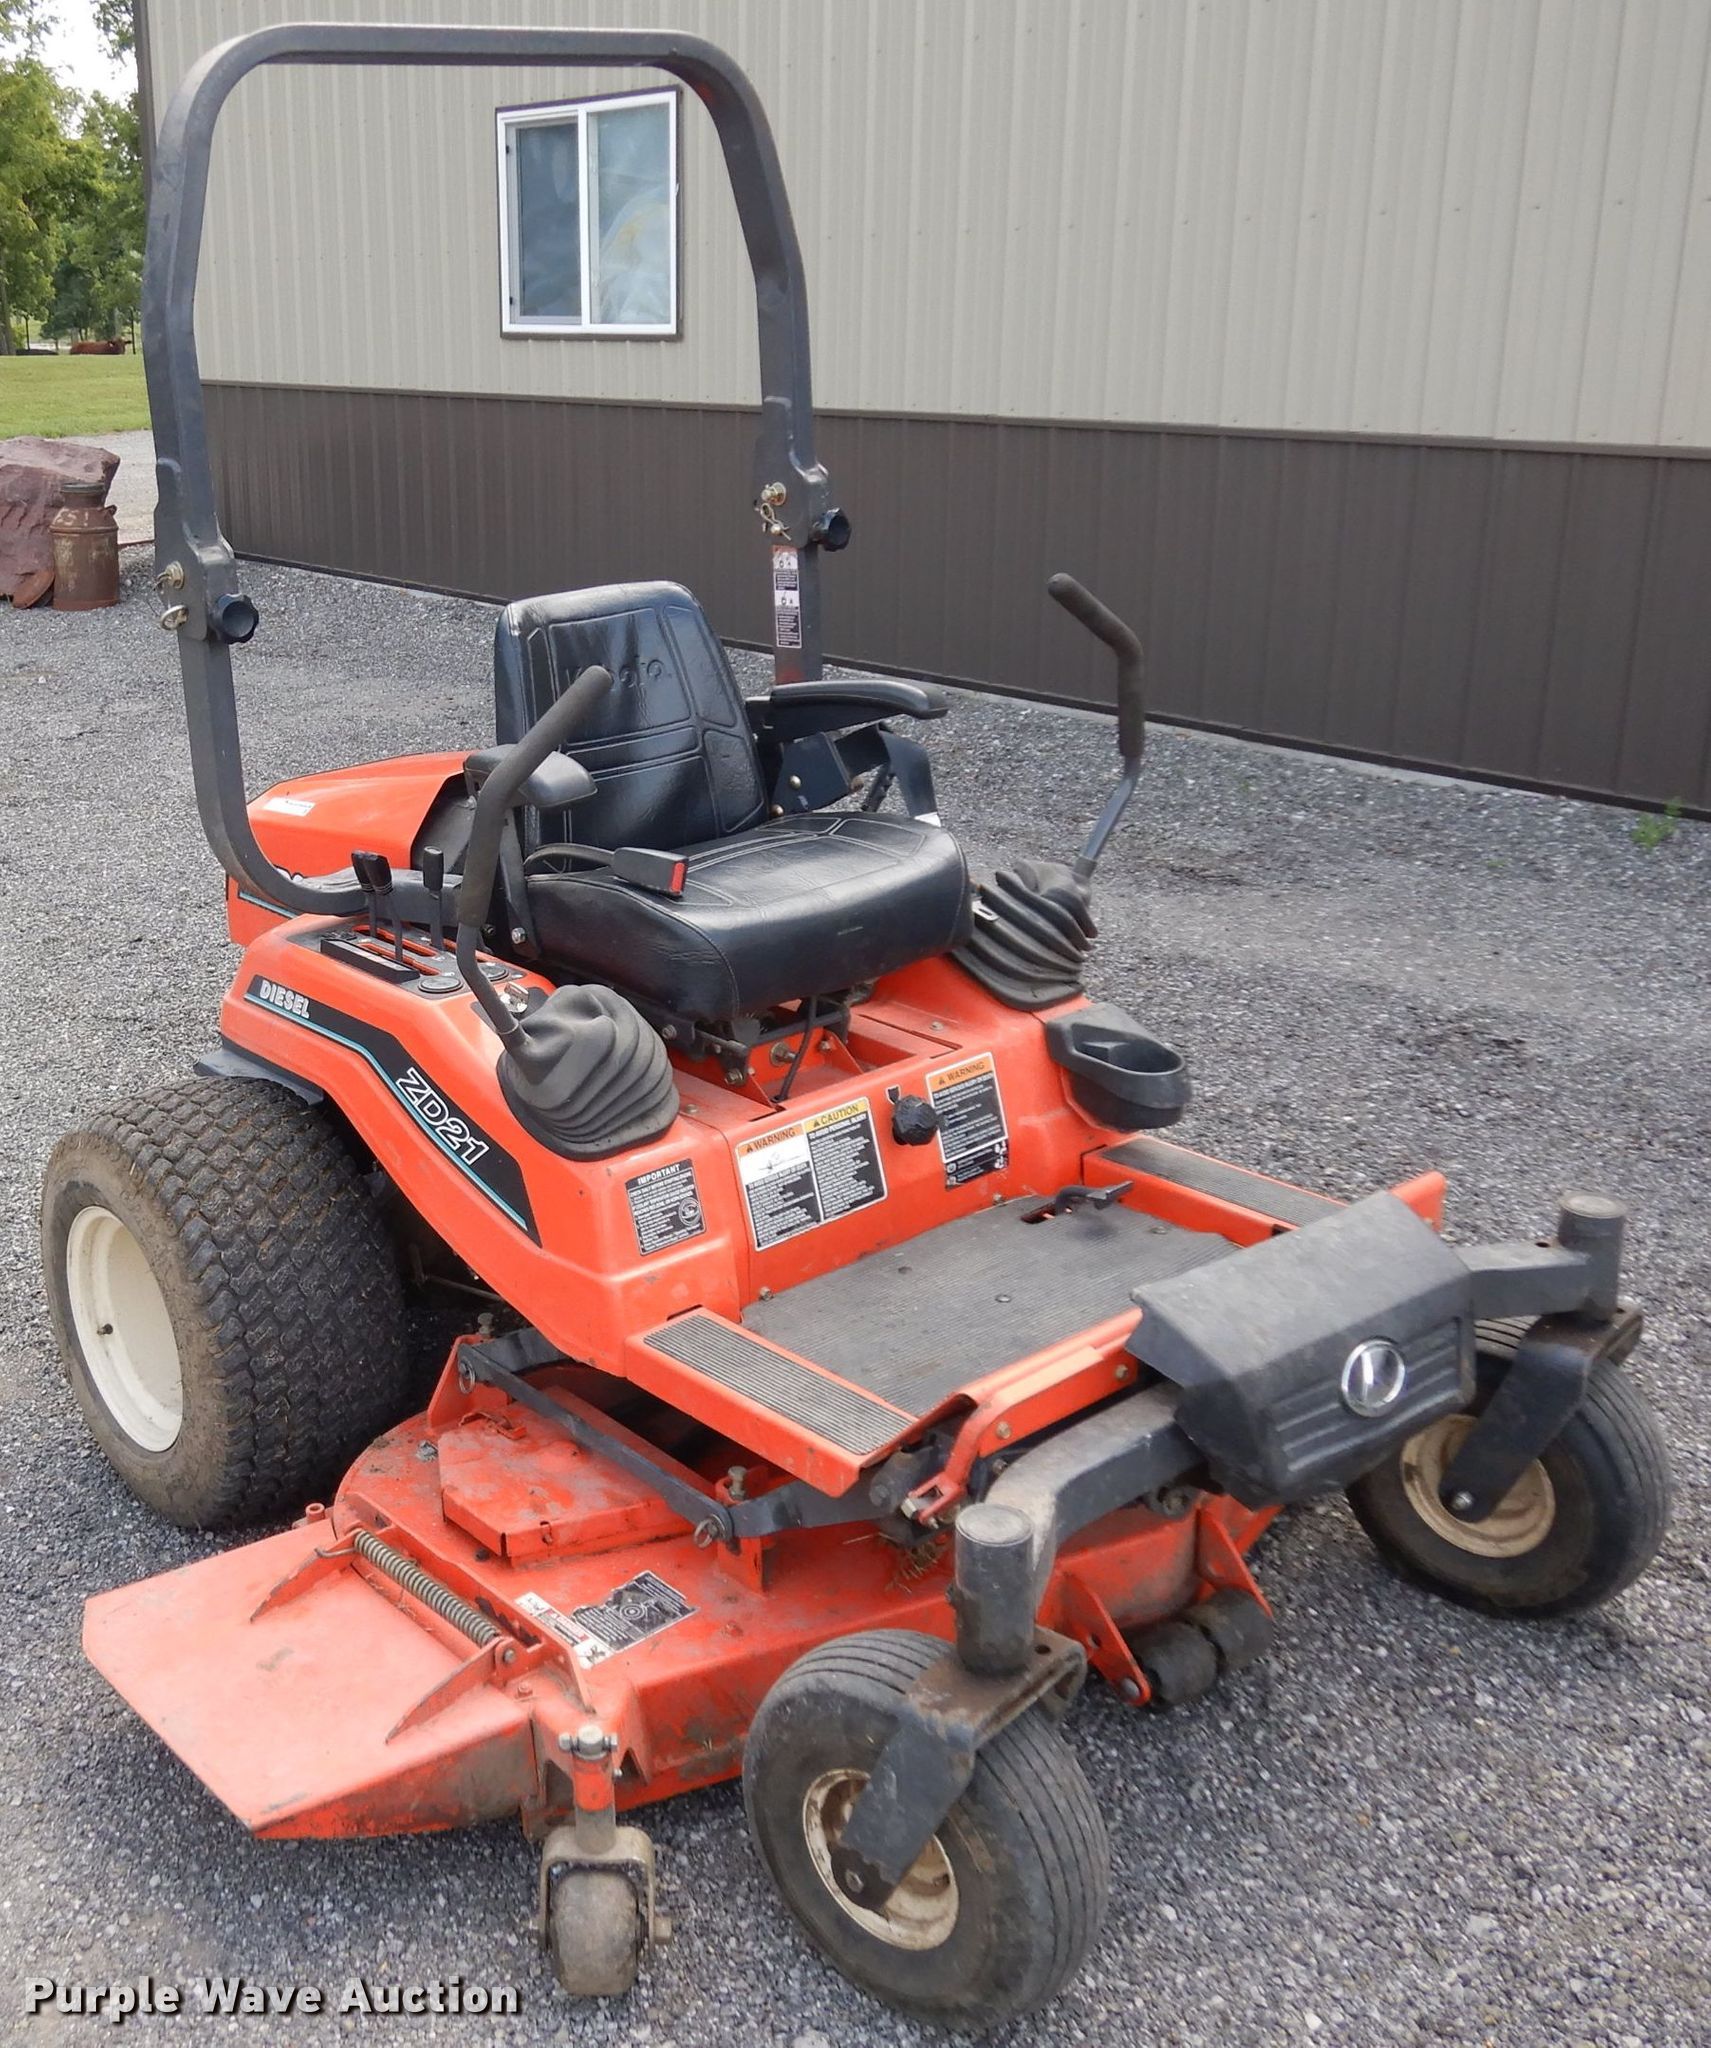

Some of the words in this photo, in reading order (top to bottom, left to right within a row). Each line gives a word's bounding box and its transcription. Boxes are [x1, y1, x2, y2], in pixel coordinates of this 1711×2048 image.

[260, 979, 310, 1019] DIESEL
[947, 1062, 985, 1081] WARNING
[395, 1067, 490, 1166] ZD21
[821, 1103, 859, 1125] CAUTION
[754, 1127, 796, 1150] WARNING
[637, 1163, 680, 1185] IMPORTANT
